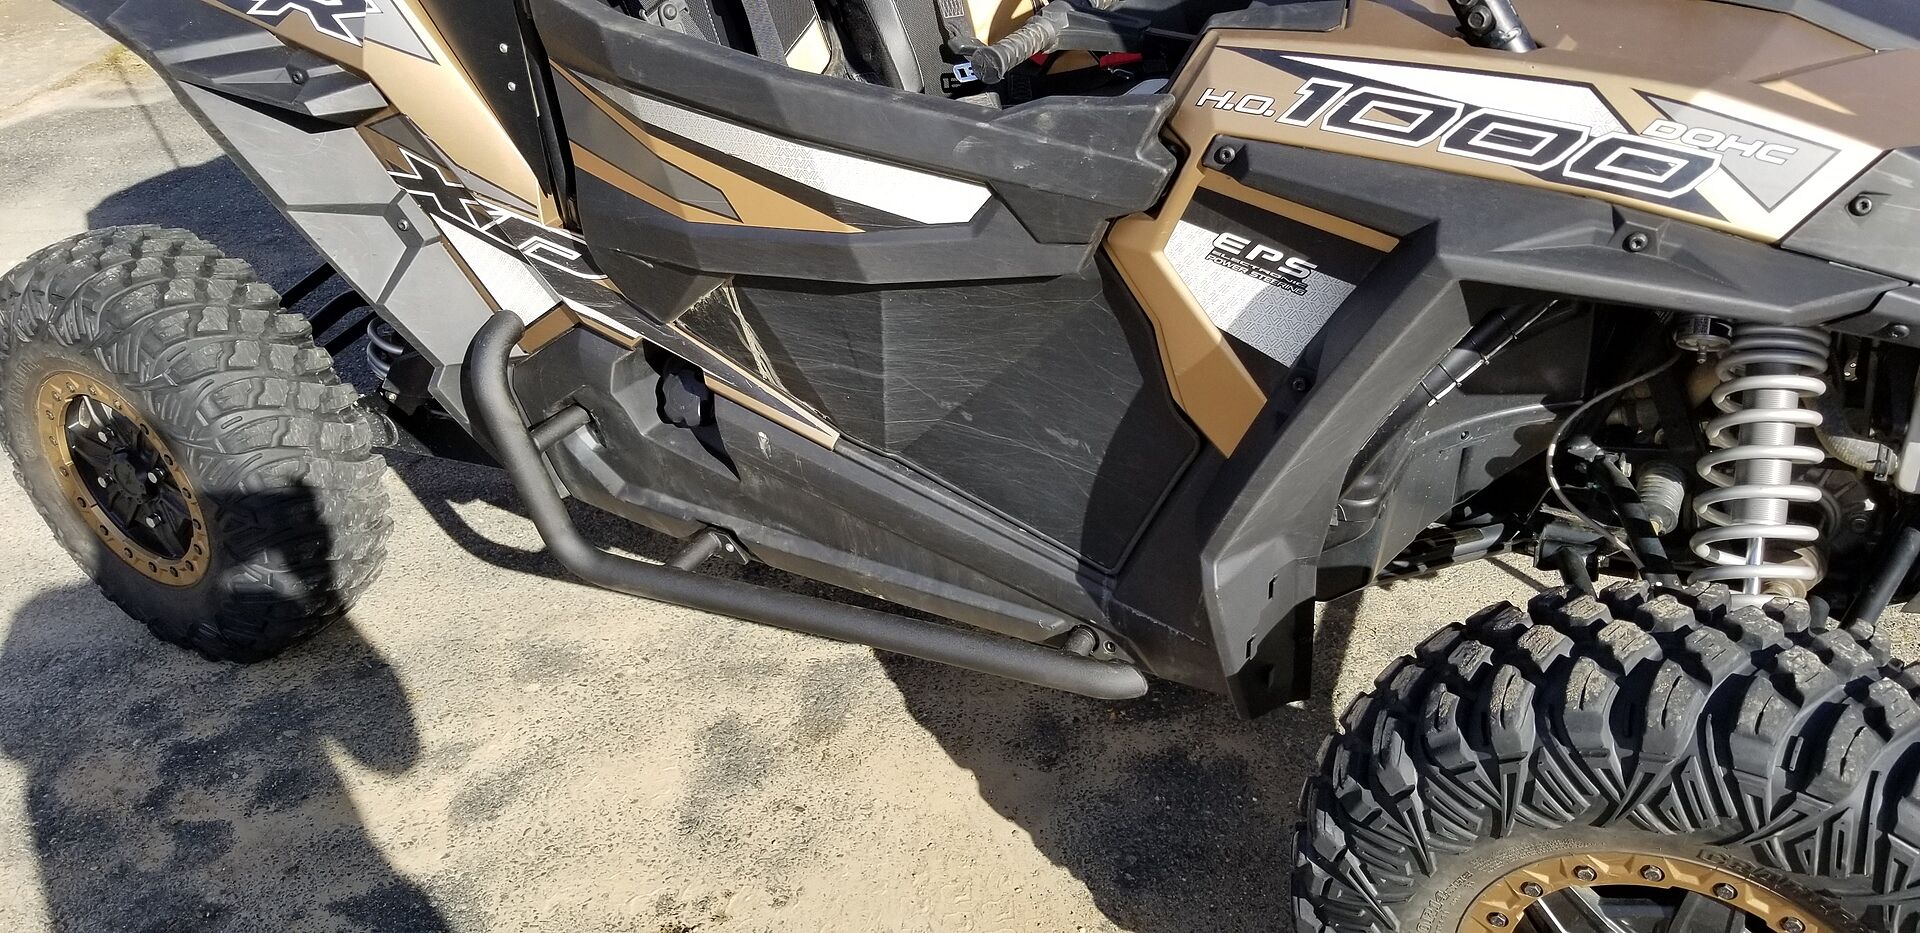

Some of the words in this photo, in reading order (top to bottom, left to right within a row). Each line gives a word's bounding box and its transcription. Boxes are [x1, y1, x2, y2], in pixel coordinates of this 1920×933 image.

[1276, 77, 1724, 199] 1000
[1641, 118, 1799, 165] DOHC
[1205, 254, 1249, 274] POWER
[1248, 271, 1308, 296] STEERING
[1211, 249, 1309, 288] ELECTRONIC
[1212, 232, 1318, 279] EPS
